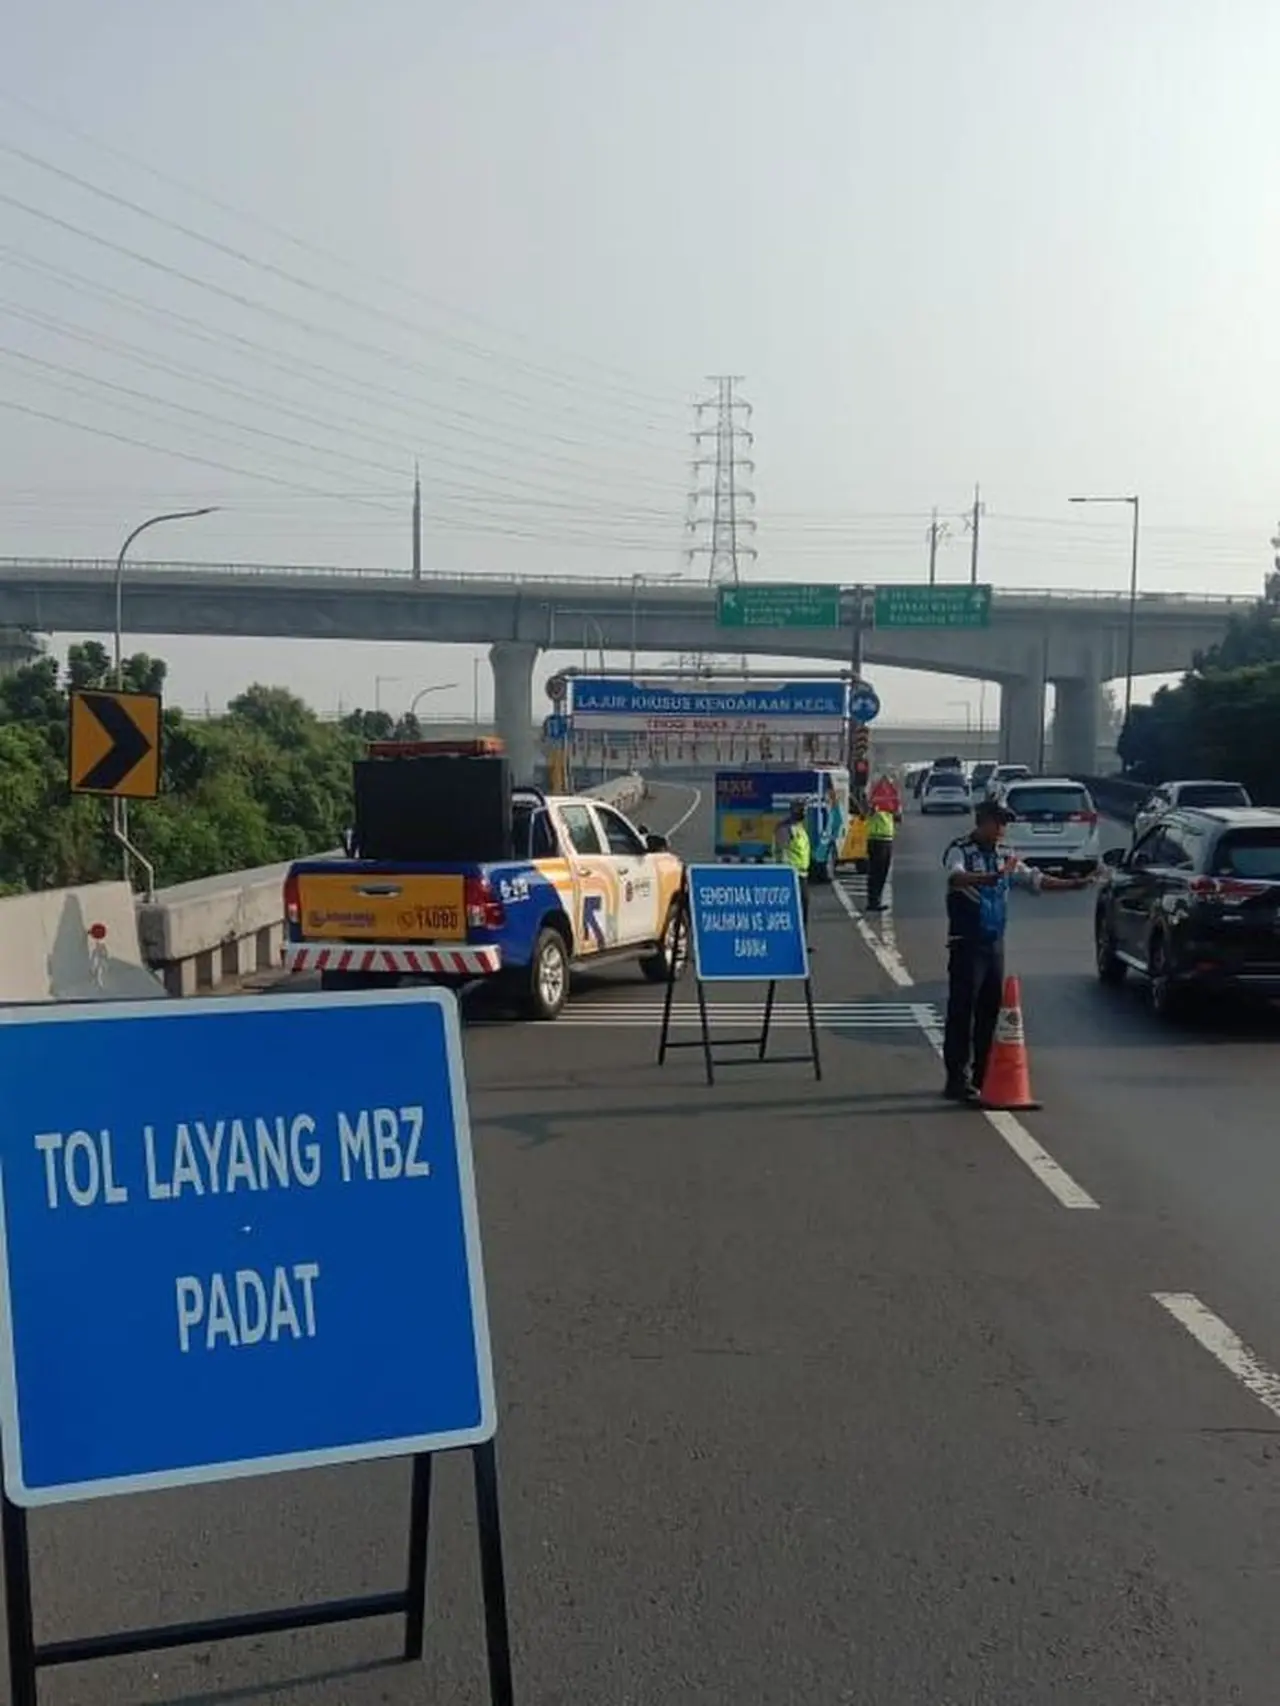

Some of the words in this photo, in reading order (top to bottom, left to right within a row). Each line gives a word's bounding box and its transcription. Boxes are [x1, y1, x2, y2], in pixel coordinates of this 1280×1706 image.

[580, 694, 627, 709] LAJUR
[631, 695, 690, 710] KHUSUS
[695, 696, 791, 711] KENDARAAN
[794, 697, 839, 711] KECIL
[35, 1130, 127, 1208] TOL
[144, 1114, 321, 1199] LAYANG
[338, 1106, 430, 1182] MBZ
[176, 1263, 319, 1352] PADAT
